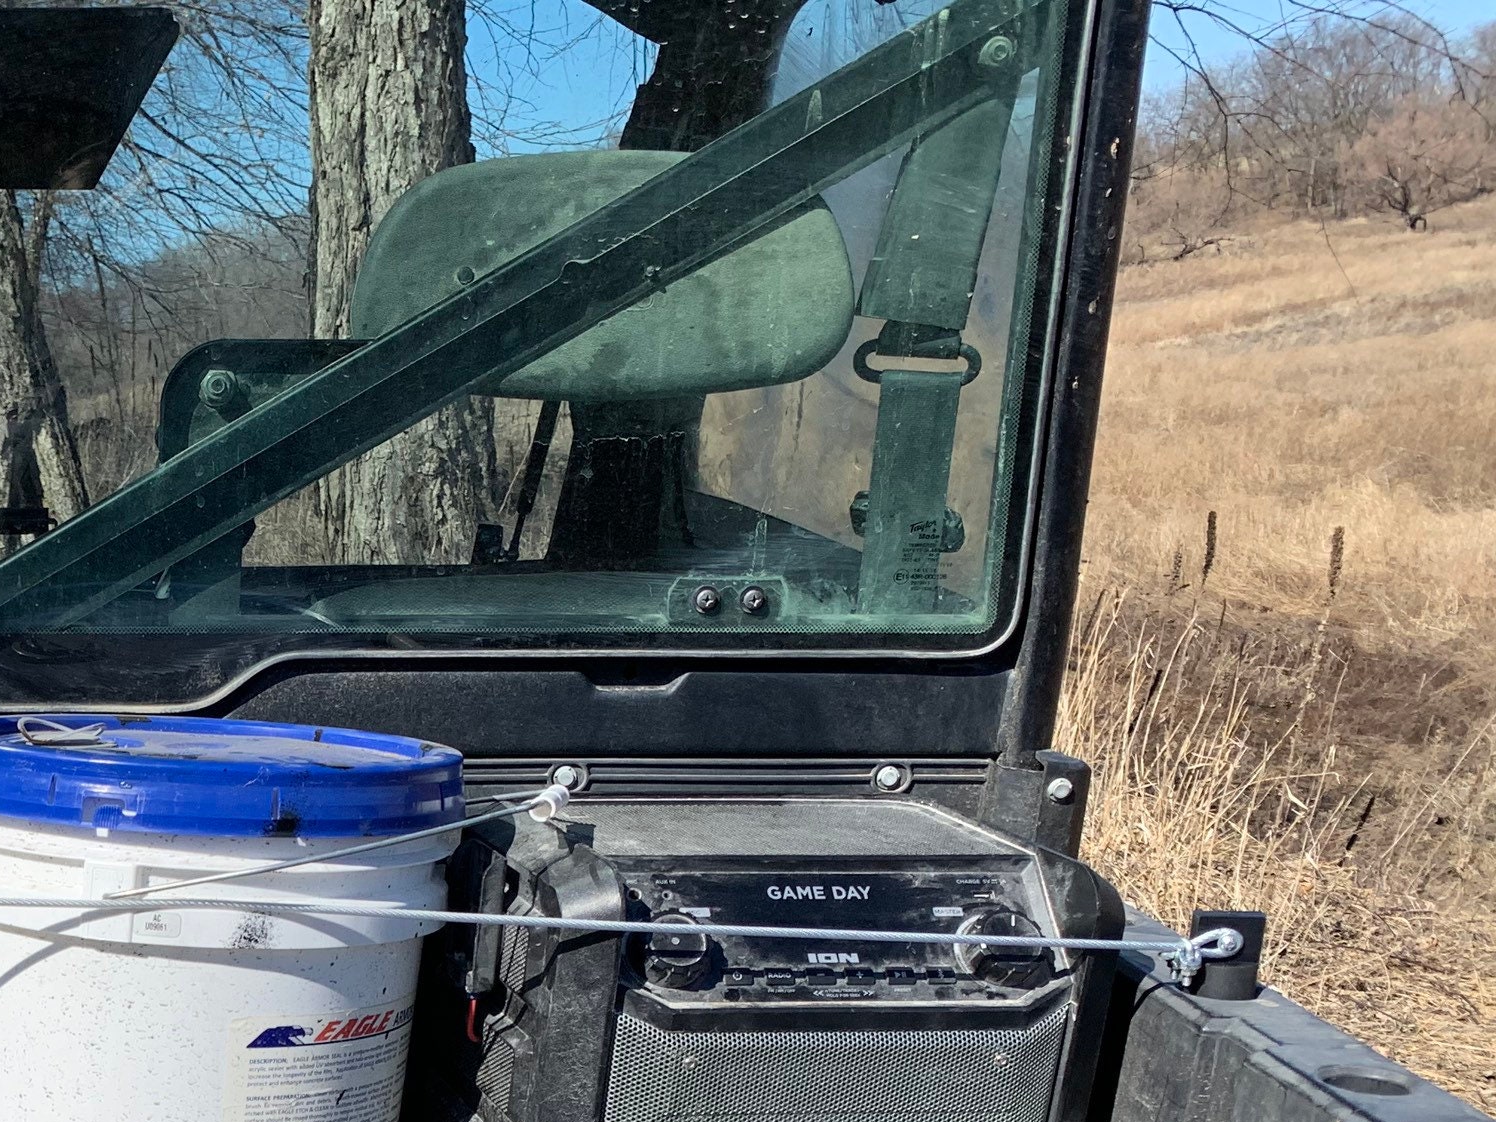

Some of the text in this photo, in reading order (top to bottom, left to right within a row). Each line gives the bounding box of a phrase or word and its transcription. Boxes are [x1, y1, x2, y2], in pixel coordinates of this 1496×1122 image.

[909, 520, 937, 533] Taylor
[766, 885, 871, 900] GAME DAY
[153, 913, 162, 922] AC
[807, 952, 860, 964] ION
[313, 1004, 414, 1042] EAGLE ARMO
